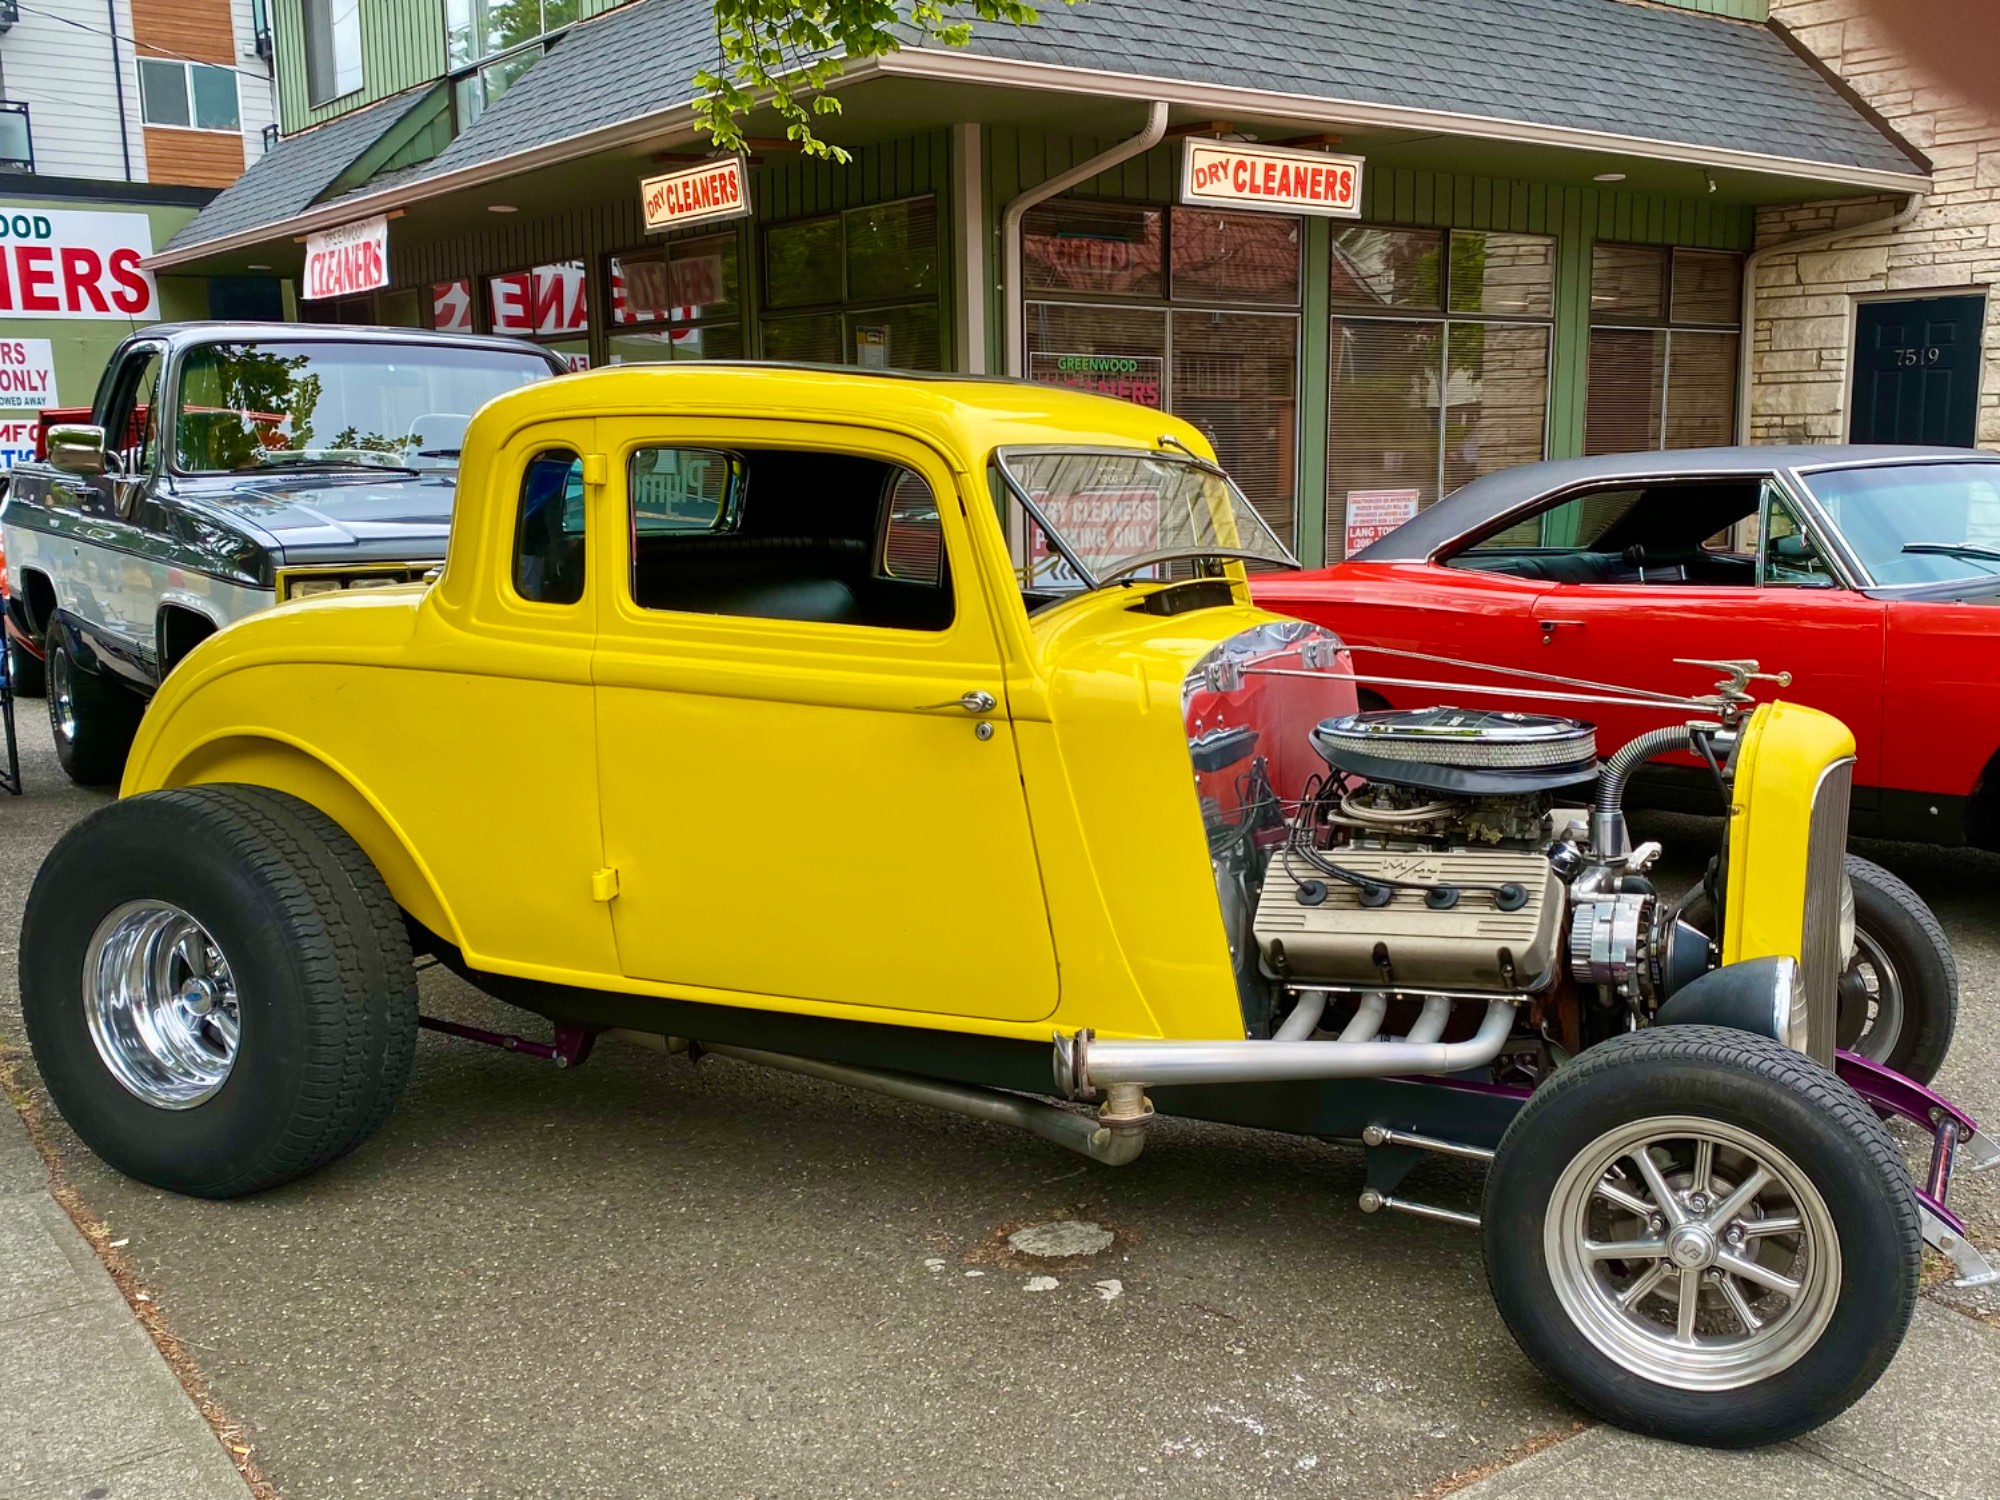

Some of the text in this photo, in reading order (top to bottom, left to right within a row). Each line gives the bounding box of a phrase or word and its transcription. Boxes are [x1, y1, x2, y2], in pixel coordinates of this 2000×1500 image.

[1195, 159, 1352, 203] DRY CLEANERS
[647, 170, 738, 219] DRY CLEANERS
[311, 239, 383, 297] CLEANERS
[1058, 357, 1138, 372] GREENWOOD
[1895, 348, 1940, 366] 7519
[0, 370, 48, 391] ONLY
[1072, 500, 1152, 522] CLEANERS
[1114, 524, 1152, 548] ONLY
[1350, 526, 1375, 537] LANG
